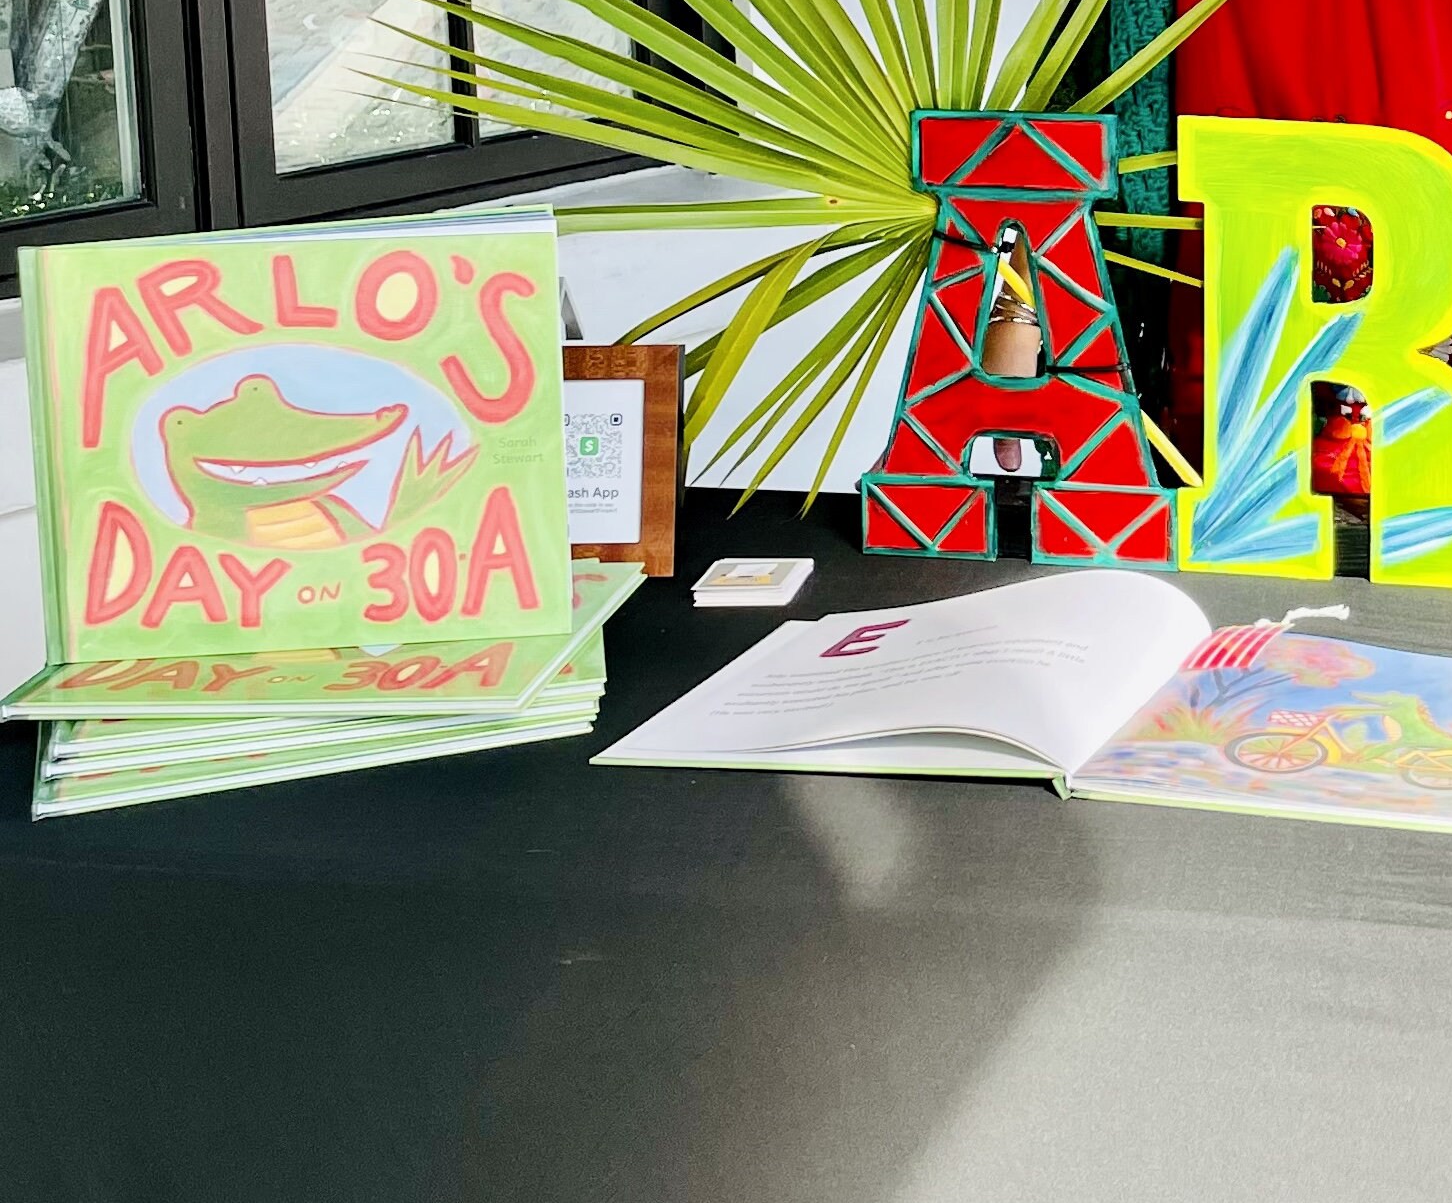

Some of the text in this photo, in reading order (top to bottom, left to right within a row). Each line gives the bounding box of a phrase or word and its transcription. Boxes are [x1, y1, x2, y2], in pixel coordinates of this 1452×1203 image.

[81, 249, 536, 449] ARLO'S
[493, 452, 545, 465] Stewart
[498, 436, 537, 448] Sarah
[566, 486, 620, 500] ash App
[84, 500, 292, 629] DAY
[818, 618, 913, 658] E
[57, 657, 274, 694] DAY
